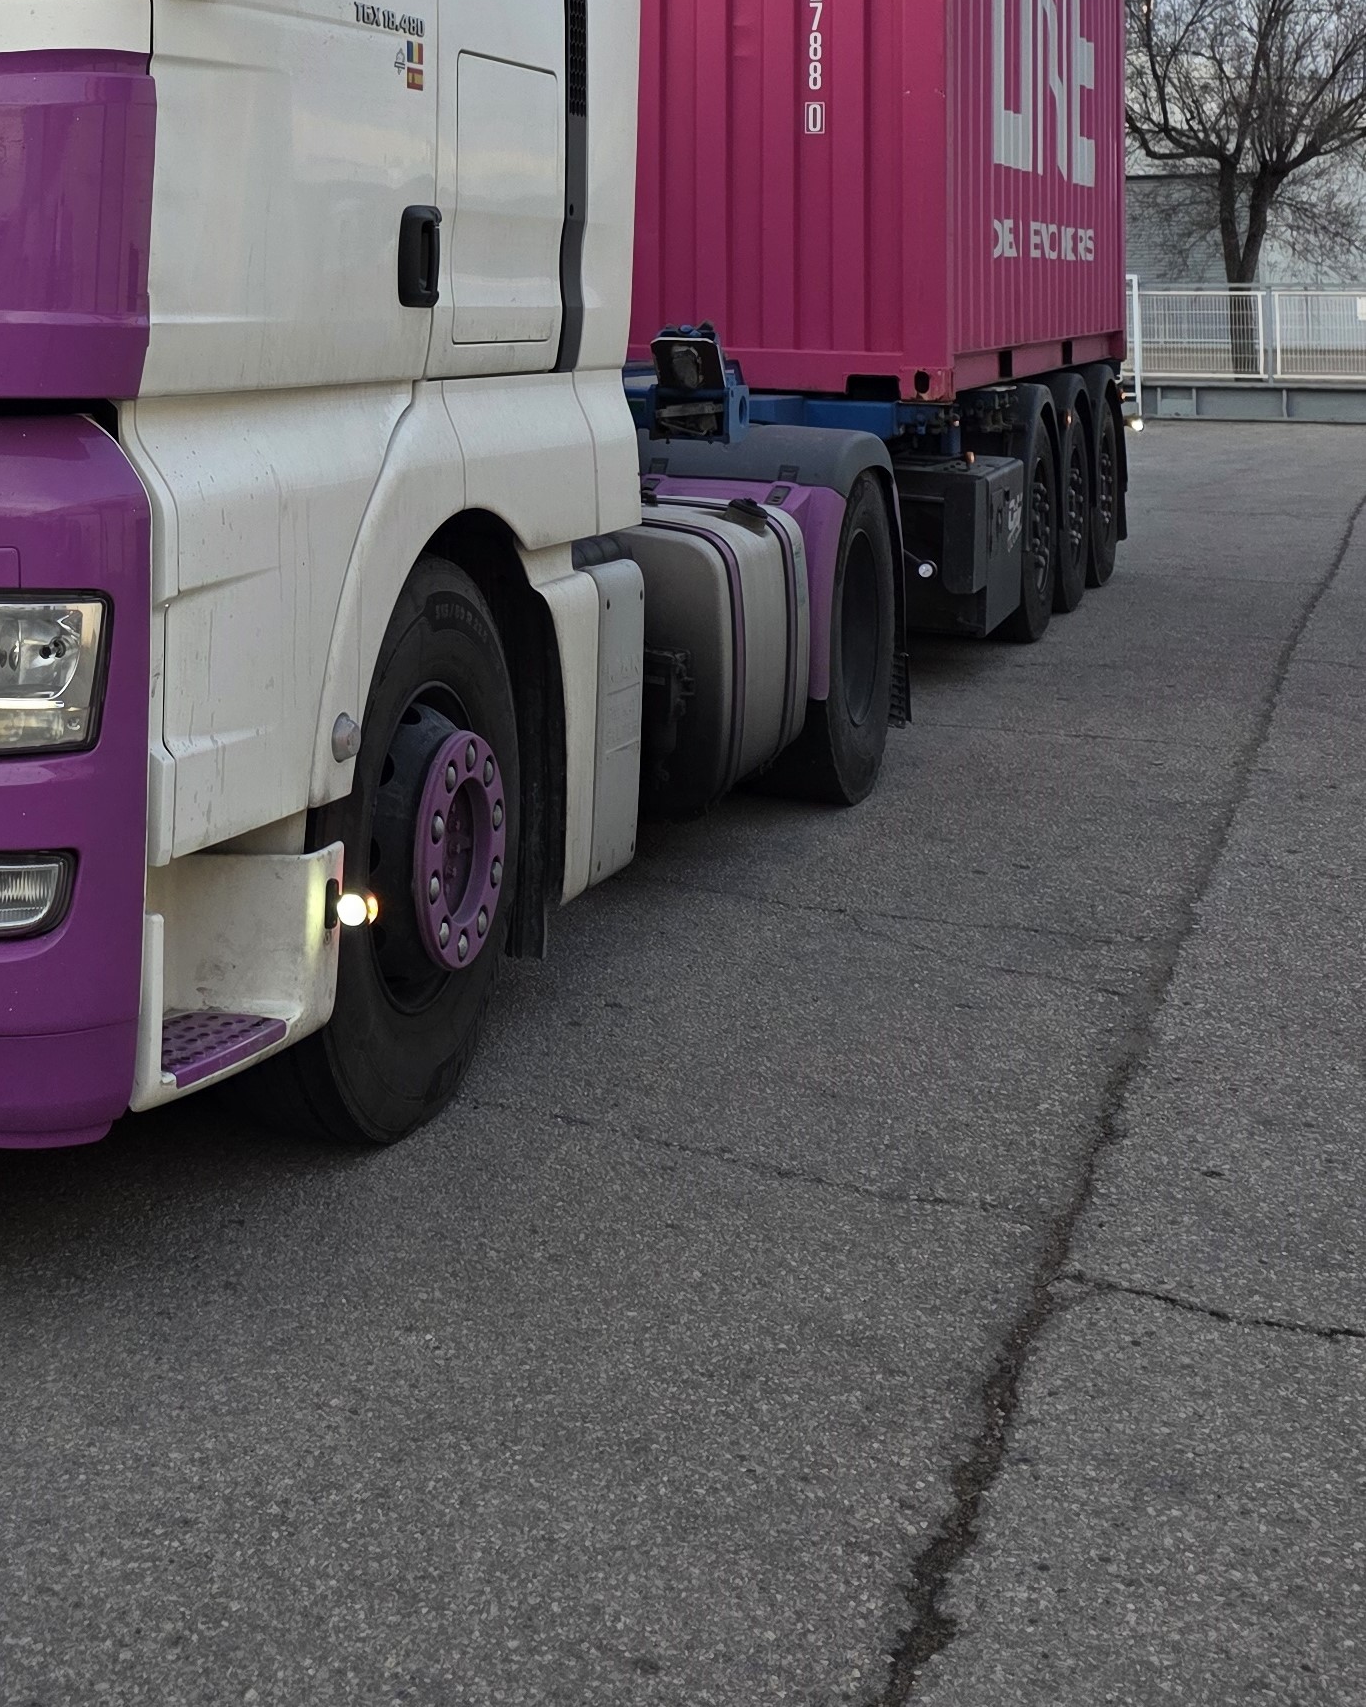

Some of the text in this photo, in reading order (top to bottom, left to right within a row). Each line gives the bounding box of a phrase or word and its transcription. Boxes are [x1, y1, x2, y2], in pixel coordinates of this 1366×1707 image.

[354, 1, 426, 38] TGX 18.480
[808, 103, 822, 132] 0
